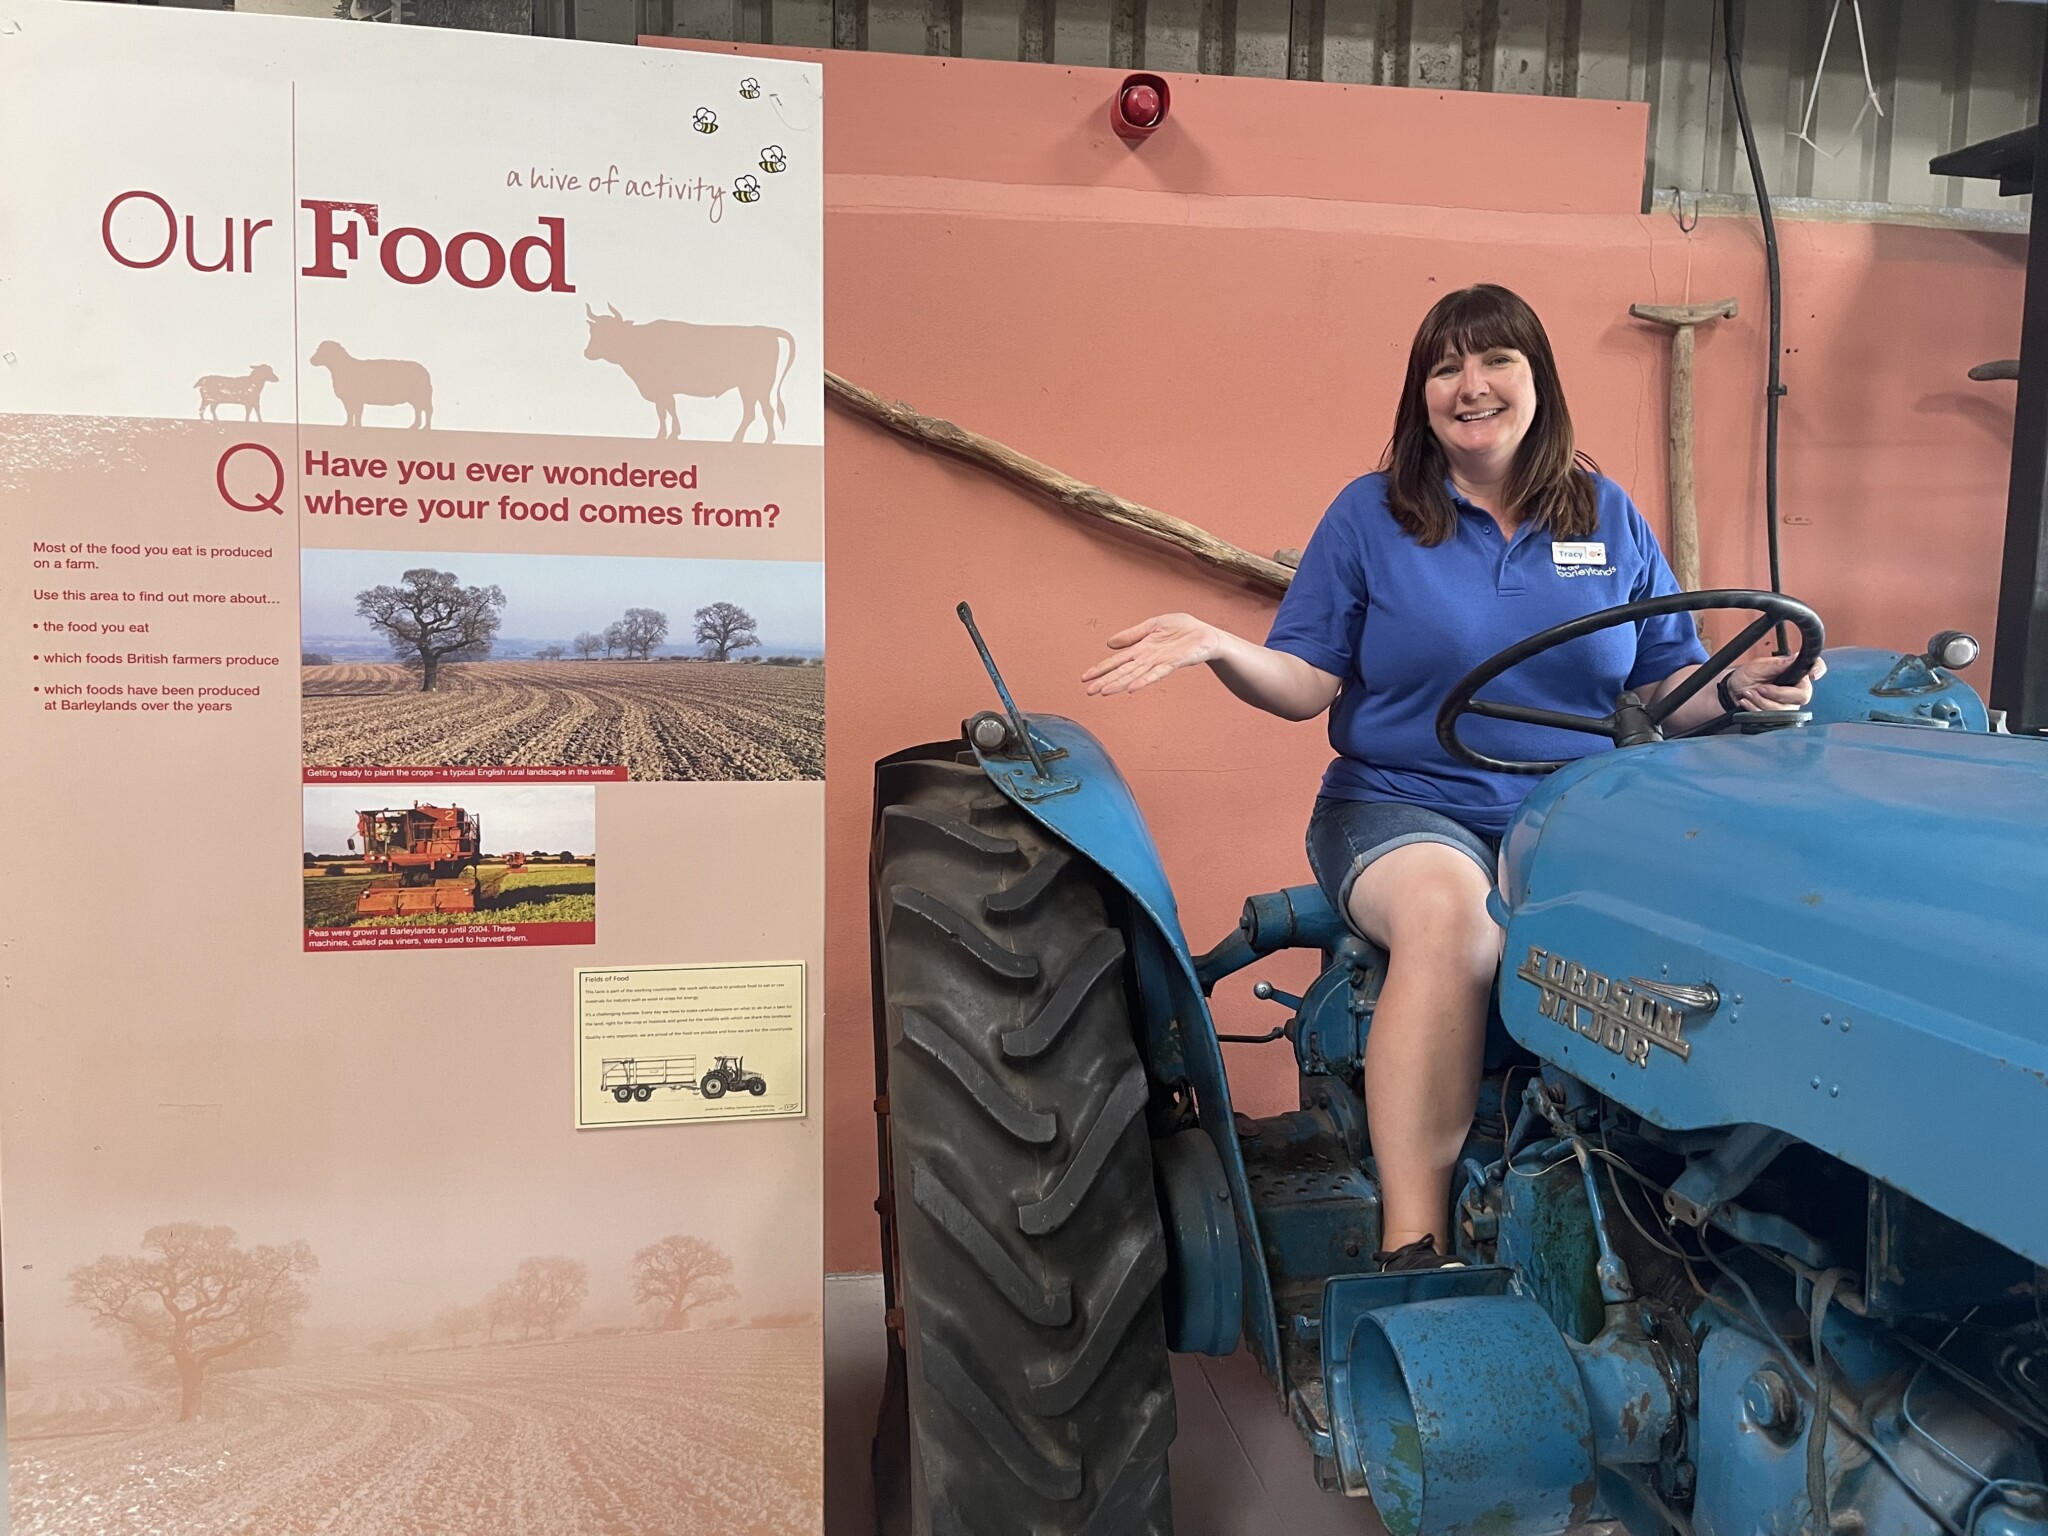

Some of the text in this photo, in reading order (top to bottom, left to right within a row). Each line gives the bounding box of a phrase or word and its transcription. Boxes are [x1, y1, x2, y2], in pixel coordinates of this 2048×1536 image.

[507, 165, 726, 223] a hive of activity
[102, 190, 576, 293] Our Food
[305, 450, 698, 490] Have you ever wondered
[217, 443, 285, 515] Q
[304, 490, 780, 528] where your food comes from?
[33, 542, 272, 558] Most of the food you eat is produced
[1558, 550, 1582, 558] Tracy
[66, 559, 98, 568] farm.
[1556, 566, 1616, 578] barleylands
[34, 589, 58, 599] Use
[62, 590, 86, 600] this
[122, 591, 135, 601] to
[139, 591, 163, 601] find
[168, 592, 188, 601] out
[43, 621, 149, 634] the food you eat
[44, 653, 278, 667] which foods British farmers produce
[44, 684, 260, 697] which foods have been produced
[44, 700, 56, 710] at
[61, 700, 137, 712] Barleylands
[172, 700, 193, 710] the
[196, 703, 232, 713] years
[307, 769, 336, 778] Getting
[339, 769, 362, 778] ready
[374, 769, 394, 777] plant
[449, 768, 475, 777] typical
[478, 768, 505, 777] English
[526, 768, 566, 776] landscape
[444, 810, 454, 821] 2
[390, 928, 435, 936] Barleylands
[1521, 945, 1685, 1043] FORDSON
[1538, 987, 1650, 1068] MAJOR
